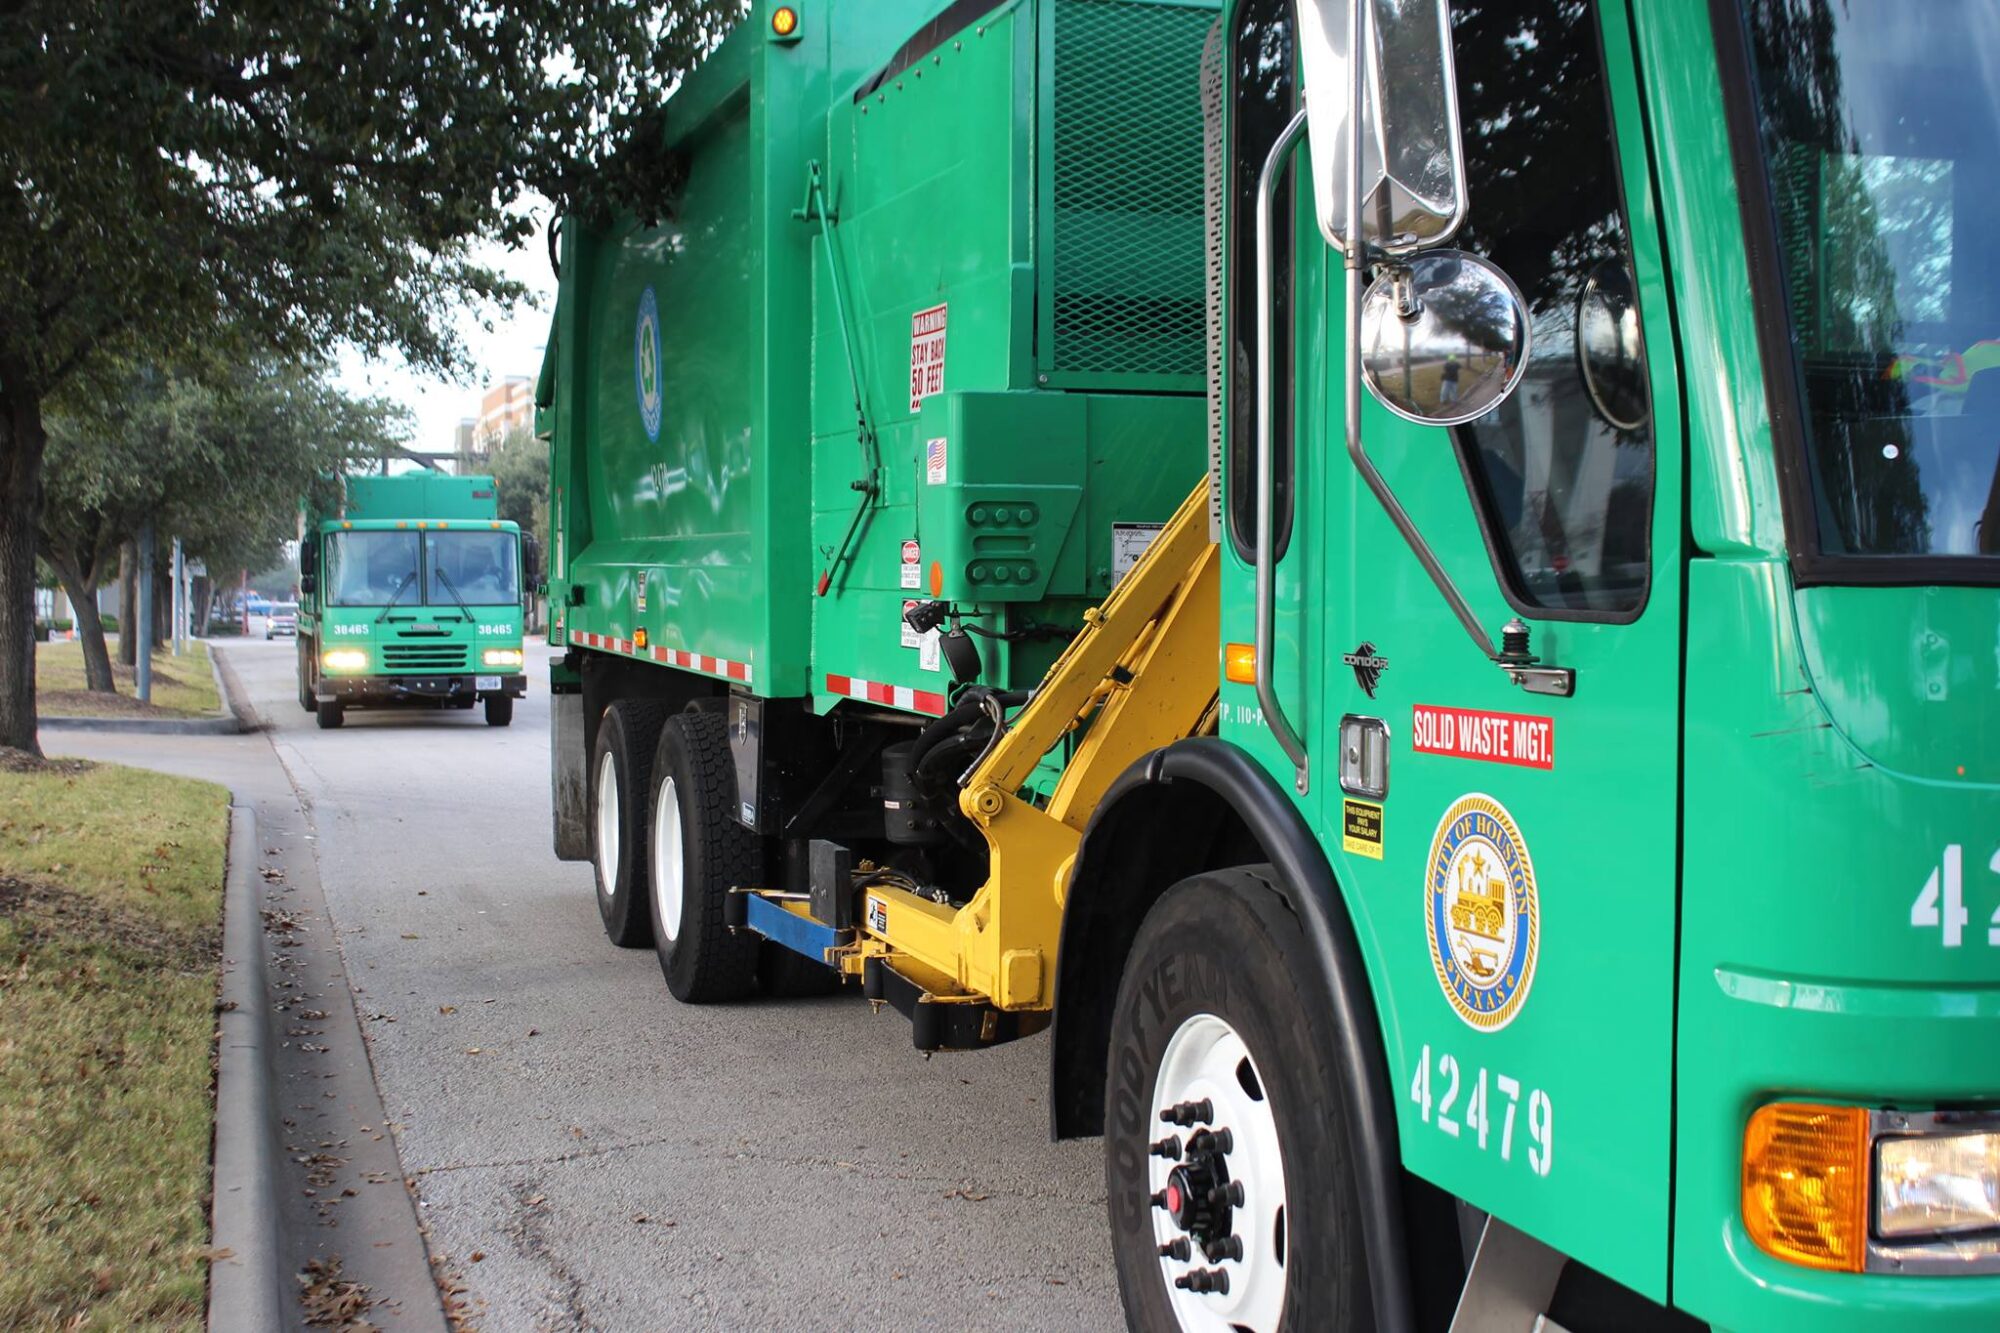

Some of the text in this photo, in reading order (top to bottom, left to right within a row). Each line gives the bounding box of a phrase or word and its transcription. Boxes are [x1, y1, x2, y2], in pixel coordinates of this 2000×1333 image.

[913, 307, 946, 336] WARNING
[912, 337, 945, 366] STAY BACK
[912, 362, 943, 396] 50 FEET
[478, 624, 512, 635] 38465
[1413, 710, 1552, 762] SOLID WASTE MGT.
[1435, 815, 1528, 915] CITY OF HOUSTON
[1452, 972, 1506, 1012] TEXAS
[1411, 1043, 1553, 1177] 42479
